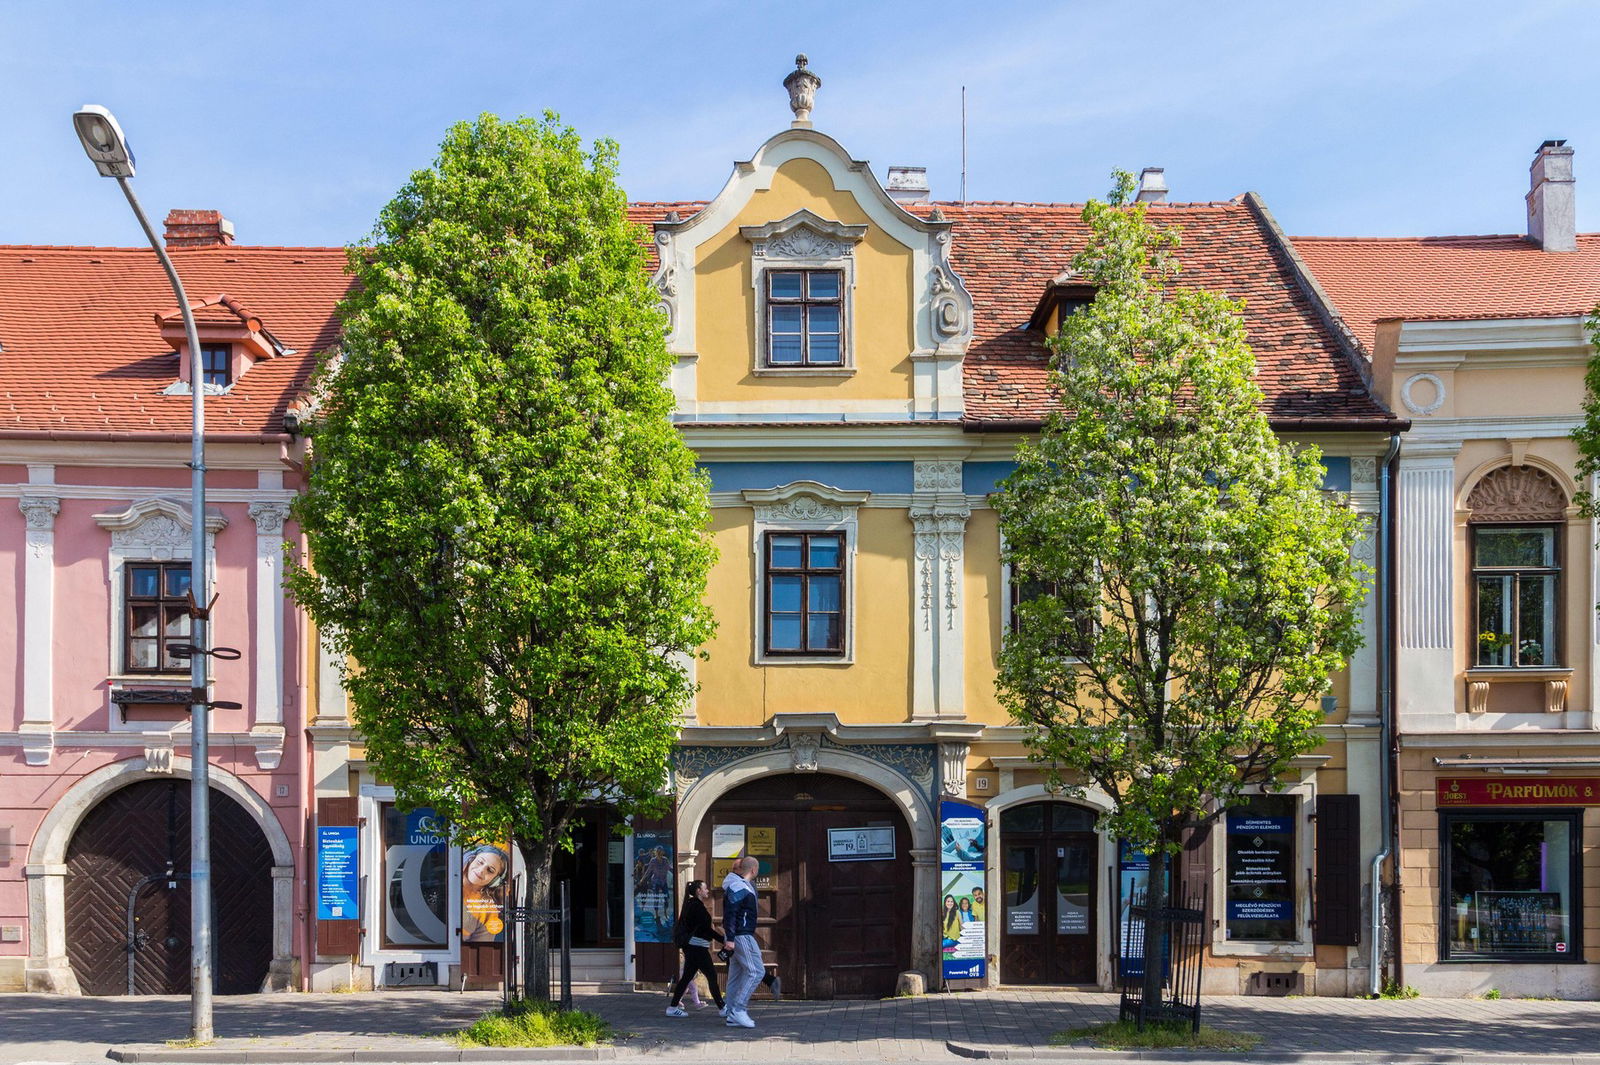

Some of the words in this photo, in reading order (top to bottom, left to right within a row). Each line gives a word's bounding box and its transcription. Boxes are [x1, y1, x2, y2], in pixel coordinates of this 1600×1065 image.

[977, 780, 986, 788] 19
[1584, 786, 1593, 797] &
[410, 835, 447, 845] UNIQA
